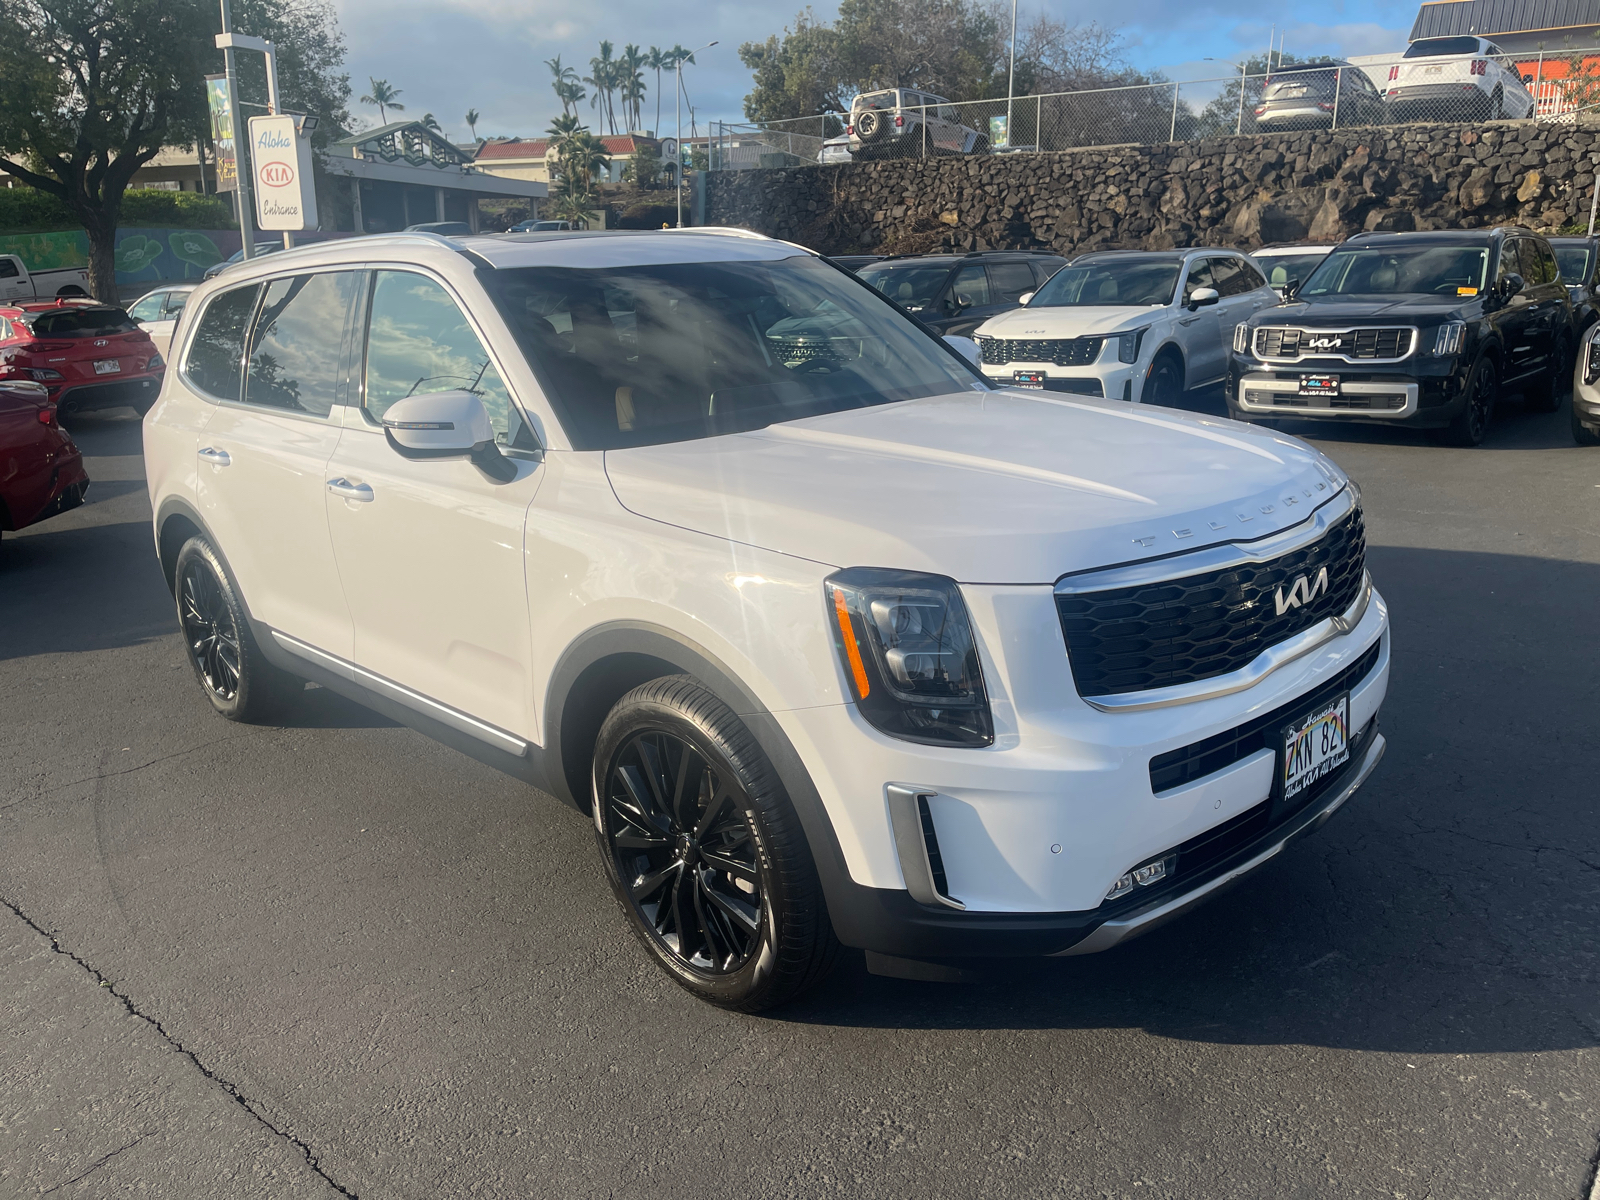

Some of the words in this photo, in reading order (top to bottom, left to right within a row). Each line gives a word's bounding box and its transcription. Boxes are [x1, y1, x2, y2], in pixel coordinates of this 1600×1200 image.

[258, 130, 291, 149] Aloha
[266, 167, 289, 182] KIA
[263, 200, 298, 216] Entrance
[1309, 338, 1342, 348] KIA
[1274, 566, 1329, 616] KIA
[1302, 703, 1334, 730] Hawaii
[1321, 710, 1344, 756] 821
[1285, 782, 1302, 801] Aloha
[1303, 767, 1319, 789] KIA
